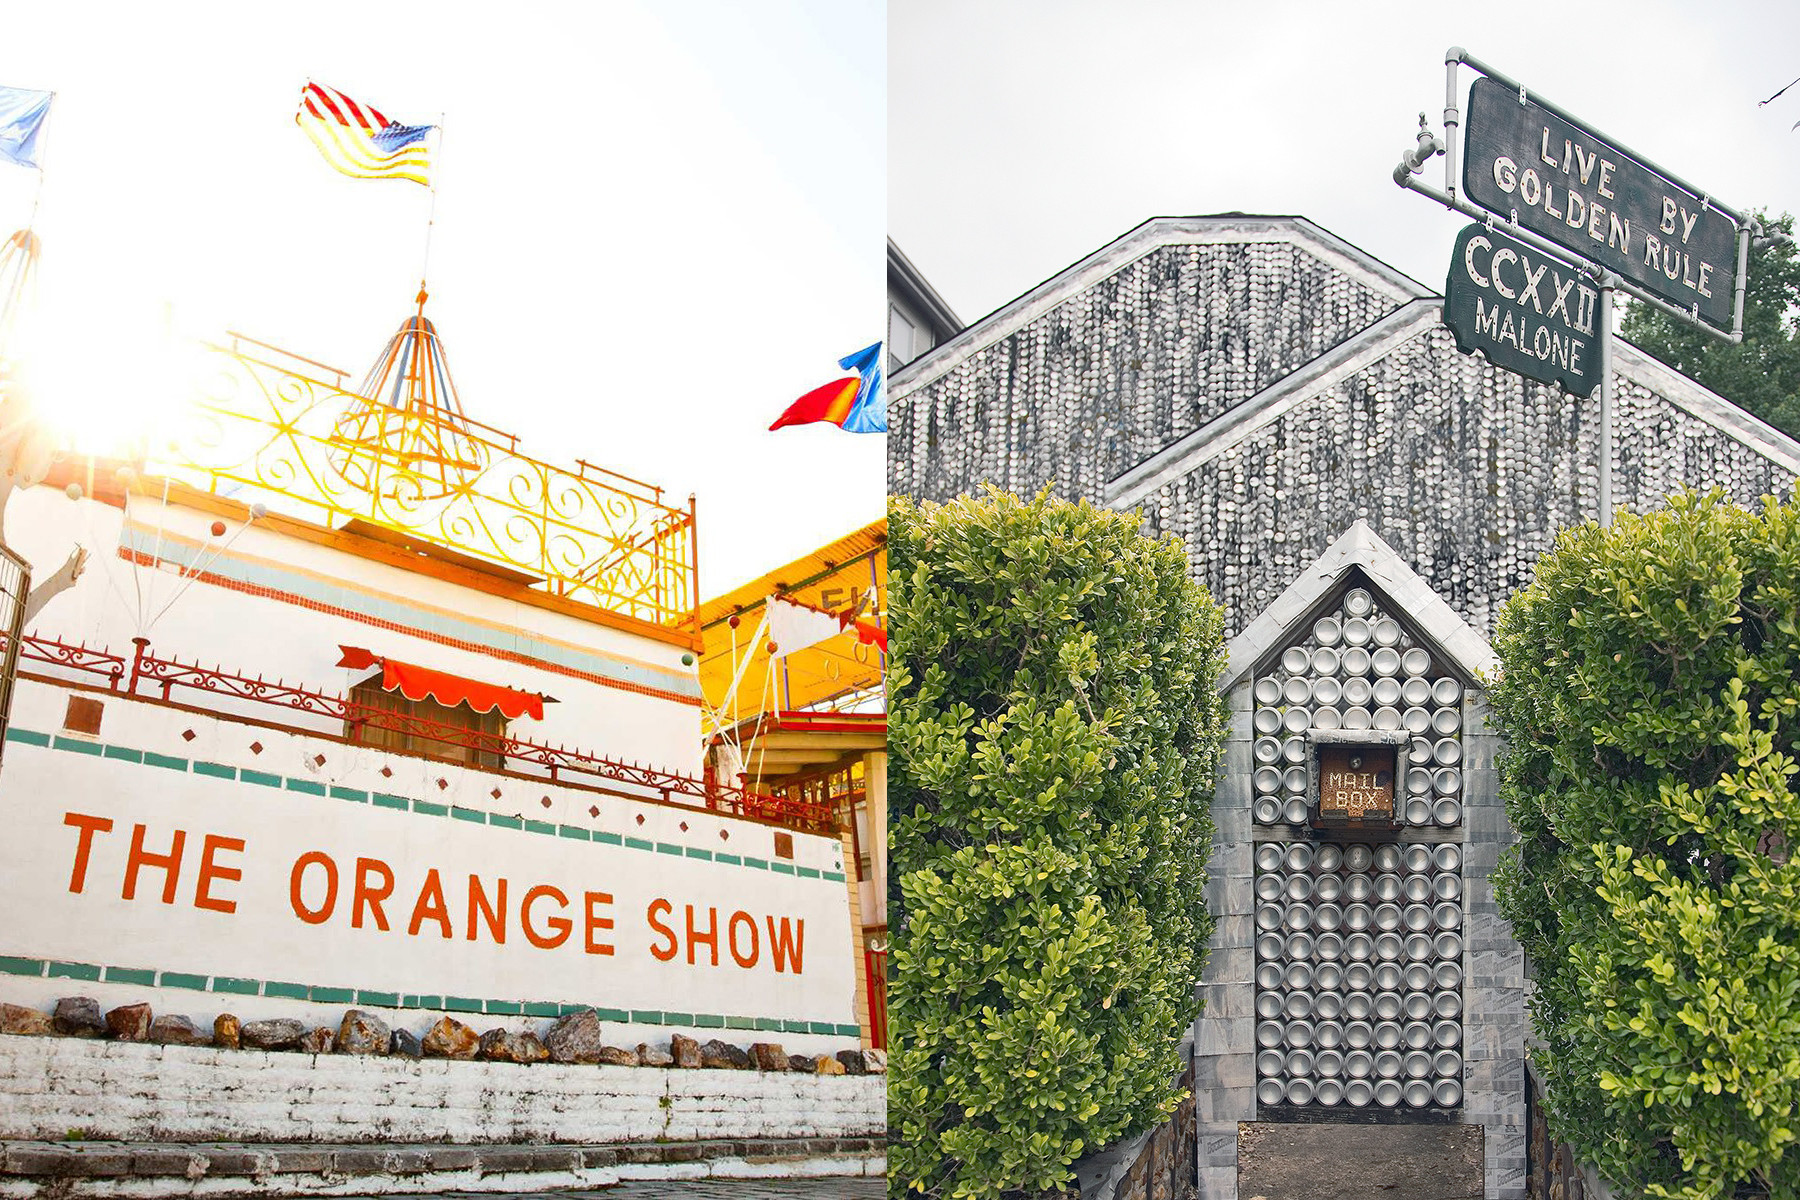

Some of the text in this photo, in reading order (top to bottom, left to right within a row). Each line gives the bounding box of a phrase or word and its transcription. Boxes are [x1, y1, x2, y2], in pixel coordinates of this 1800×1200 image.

[1493, 156, 1714, 298] GOLDEN RULE
[1541, 126, 1698, 244] LIVE BY
[1464, 235, 1598, 338] CCXXII
[1474, 296, 1585, 377] MALONE
[1329, 773, 1383, 790] MAIL
[1336, 791, 1377, 808] BOX
[63, 812, 805, 975] THE ORANGE SHOW
